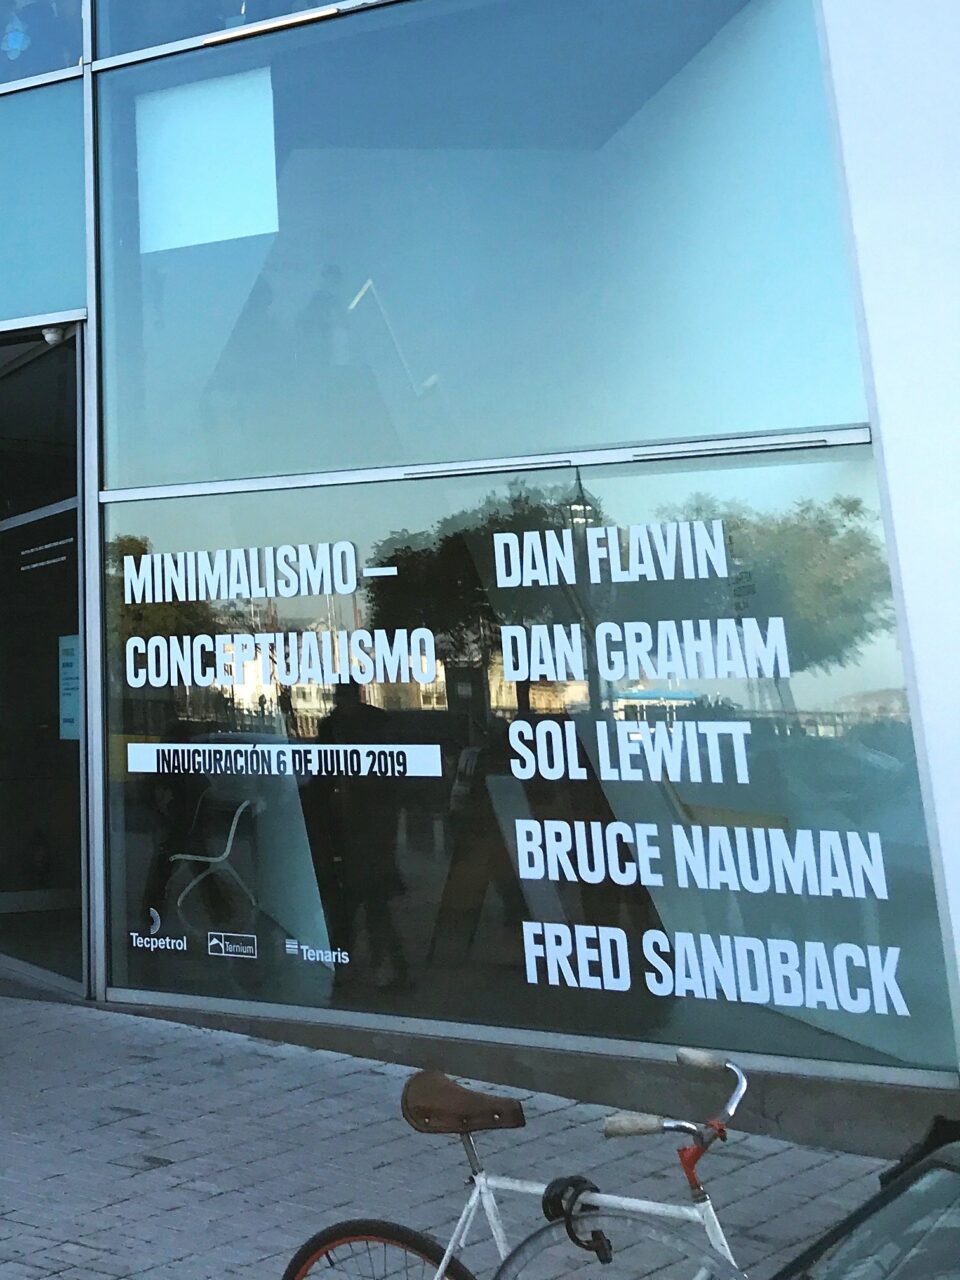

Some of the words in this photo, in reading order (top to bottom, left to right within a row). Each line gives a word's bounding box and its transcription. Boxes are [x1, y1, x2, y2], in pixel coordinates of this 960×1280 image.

[493, 528, 577, 588] DAN
[586, 519, 729, 584] FLAVIN
[125, 627, 437, 688] CONCEPTUALISMO
[500, 623, 585, 682] DAN
[595, 616, 790, 682] GRAHAM
[156, 744, 272, 775] INAUGURACIÓN
[276, 749, 287, 775] 6
[292, 749, 312, 775] DE
[317, 748, 361, 776] JULIO
[366, 750, 407, 777] 2019
[508, 720, 588, 781] SOL
[595, 720, 752, 784] LEWITT
[515, 819, 664, 887] BRUCE
[672, 824, 889, 901] NAUMAN
[129, 932, 187, 952] Tecpetrol
[224, 941, 254, 956] Ternium
[300, 945, 350, 965] Tenaris
[521, 920, 632, 992] FRED
[642, 929, 911, 1018] SANDBACK
